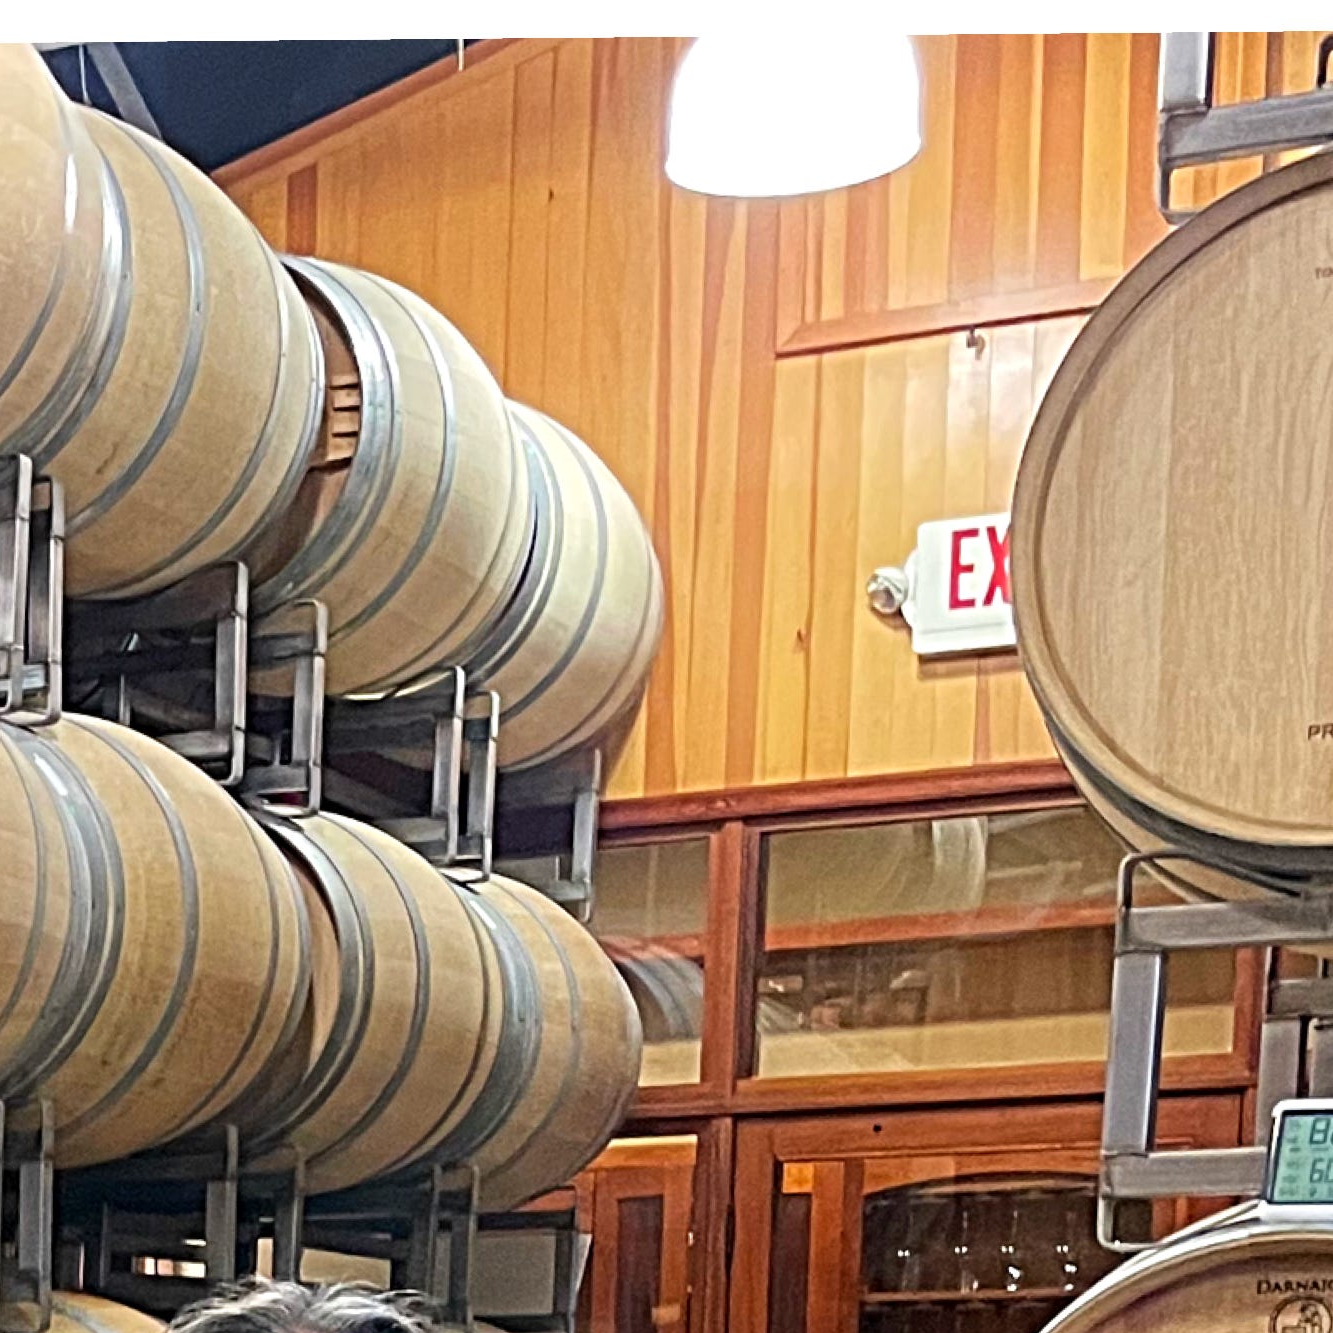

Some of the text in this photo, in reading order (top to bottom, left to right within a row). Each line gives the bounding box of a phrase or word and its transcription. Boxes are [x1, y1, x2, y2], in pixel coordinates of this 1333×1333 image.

[948, 527, 1011, 610] EX
[1308, 723, 1333, 740] PR
[1309, 1118, 1333, 1144] 8
